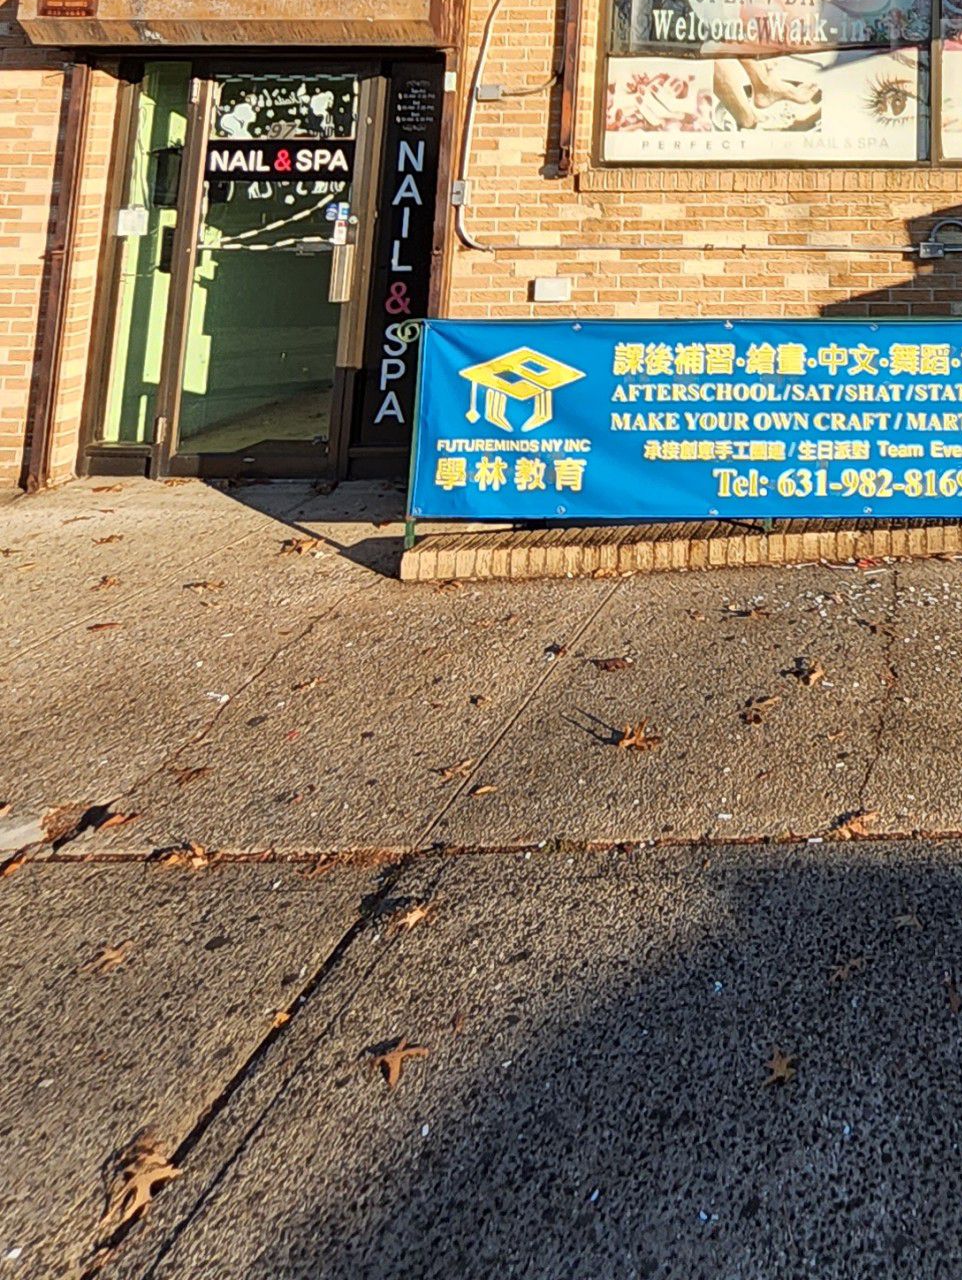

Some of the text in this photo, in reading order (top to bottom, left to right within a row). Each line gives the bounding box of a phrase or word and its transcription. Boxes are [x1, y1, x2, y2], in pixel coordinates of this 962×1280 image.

[652, 9, 866, 44] Welcome Walk-in
[269, 123, 297, 138] 97
[641, 140, 748, 151] PERFECT
[857, 137, 890, 149] SPA
[210, 149, 349, 172] NAIL & SPA
[391, 140, 426, 271] NAIL
[385, 282, 411, 315] &
[373, 322, 409, 424] SPA
[610, 412, 681, 431] MAKE
[683, 412, 749, 431] YOUR
[753, 412, 808, 431] OWN
[812, 412, 892, 431] CRAFT
[436, 439, 591, 453] FUTUREMINDS NY INC
[877, 440, 924, 458] Team
[435, 457, 588, 492] 學林教育
[712, 468, 769, 498] Tel:
